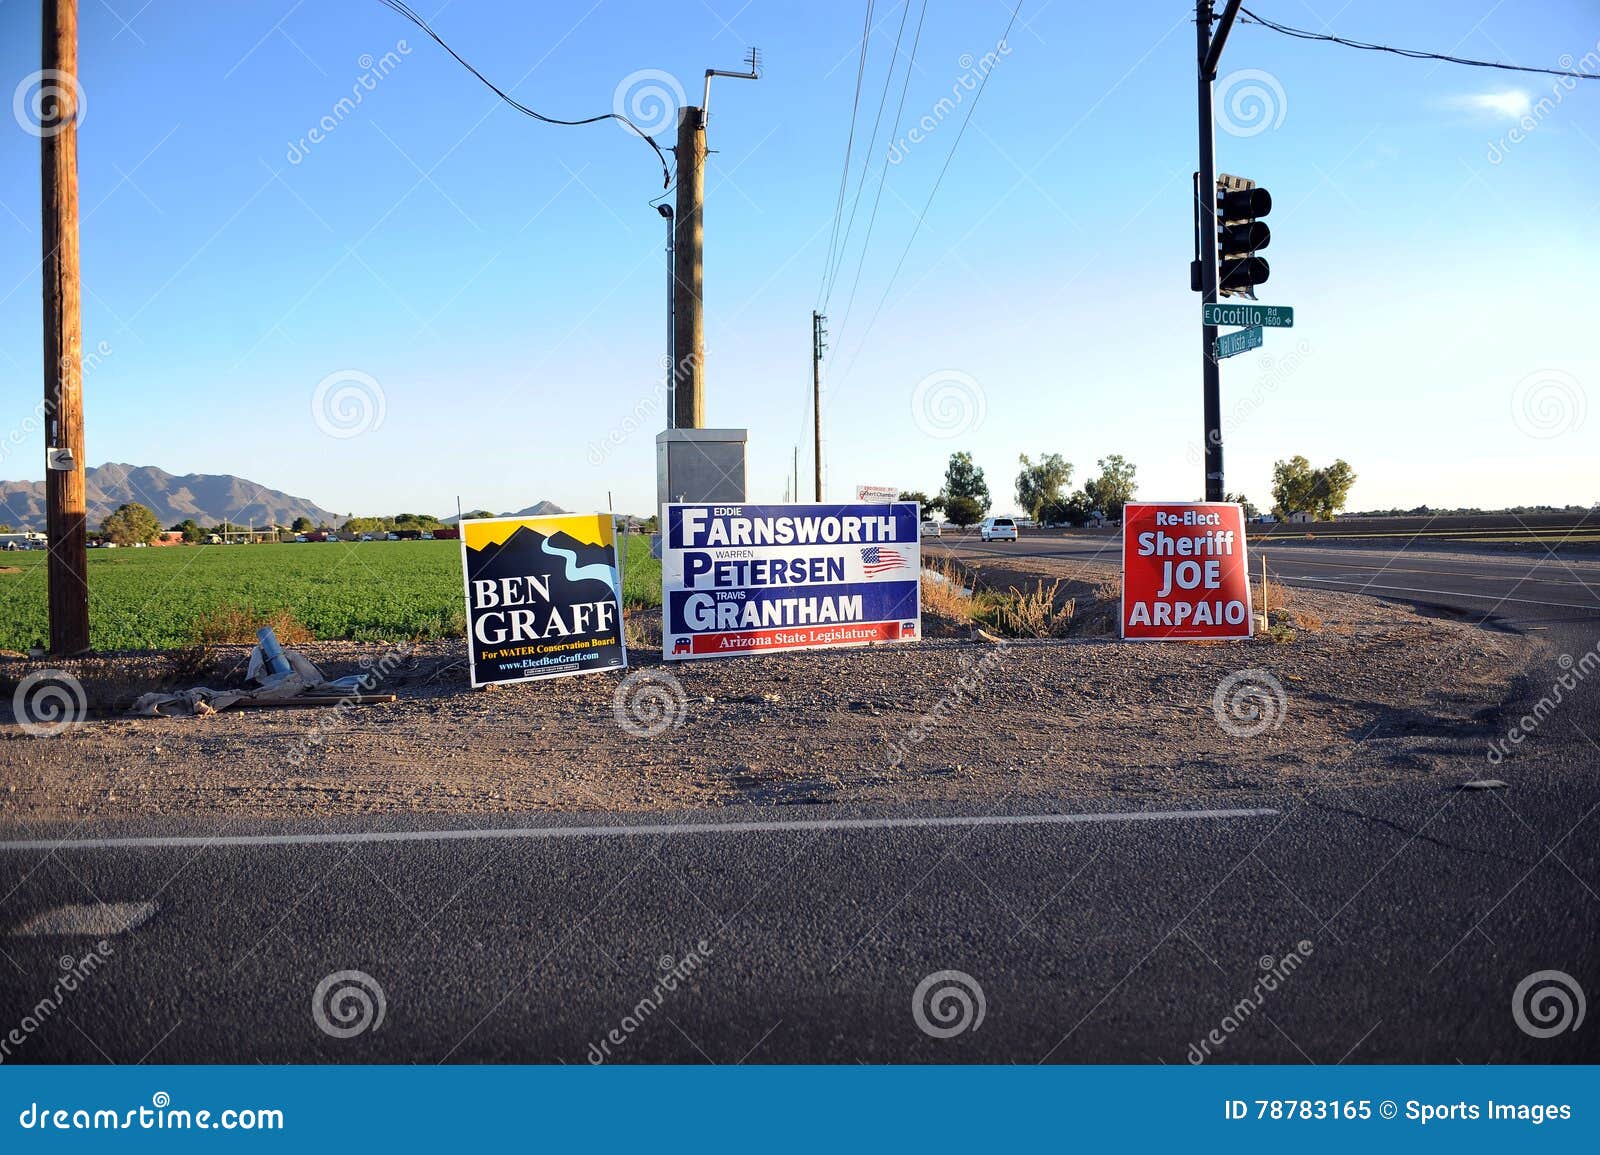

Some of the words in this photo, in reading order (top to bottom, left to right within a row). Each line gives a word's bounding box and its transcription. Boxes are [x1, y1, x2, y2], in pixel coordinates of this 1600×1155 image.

[1213, 307, 1260, 325] Ocotillo
[1267, 307, 1277, 316] Rd
[1231, 334, 1246, 352] Vista
[714, 508, 742, 516] EDDIE
[1156, 511, 1220, 526] Re-Elect
[682, 508, 896, 546] FARNSWORTH
[716, 550, 754, 559] WARREN
[1138, 530, 1234, 556] Sheriff
[683, 551, 845, 588] PETERSEN
[1157, 560, 1220, 598] JOE
[472, 574, 550, 610] BEN
[716, 591, 746, 601] TRAVIS
[475, 600, 616, 645] GRAFF
[683, 593, 863, 631] GRANTHAM
[1128, 600, 1245, 626] ARPAIO
[482, 651, 498, 660] For
[499, 646, 535, 658] WATER
[536, 639, 590, 653] Conservation
[591, 637, 616, 647] Board
[719, 636, 772, 649] Arizona
[775, 631, 806, 644] State
[809, 626, 878, 643] Legislature
[499, 652, 600, 670] www.ElectBenGraff.com
